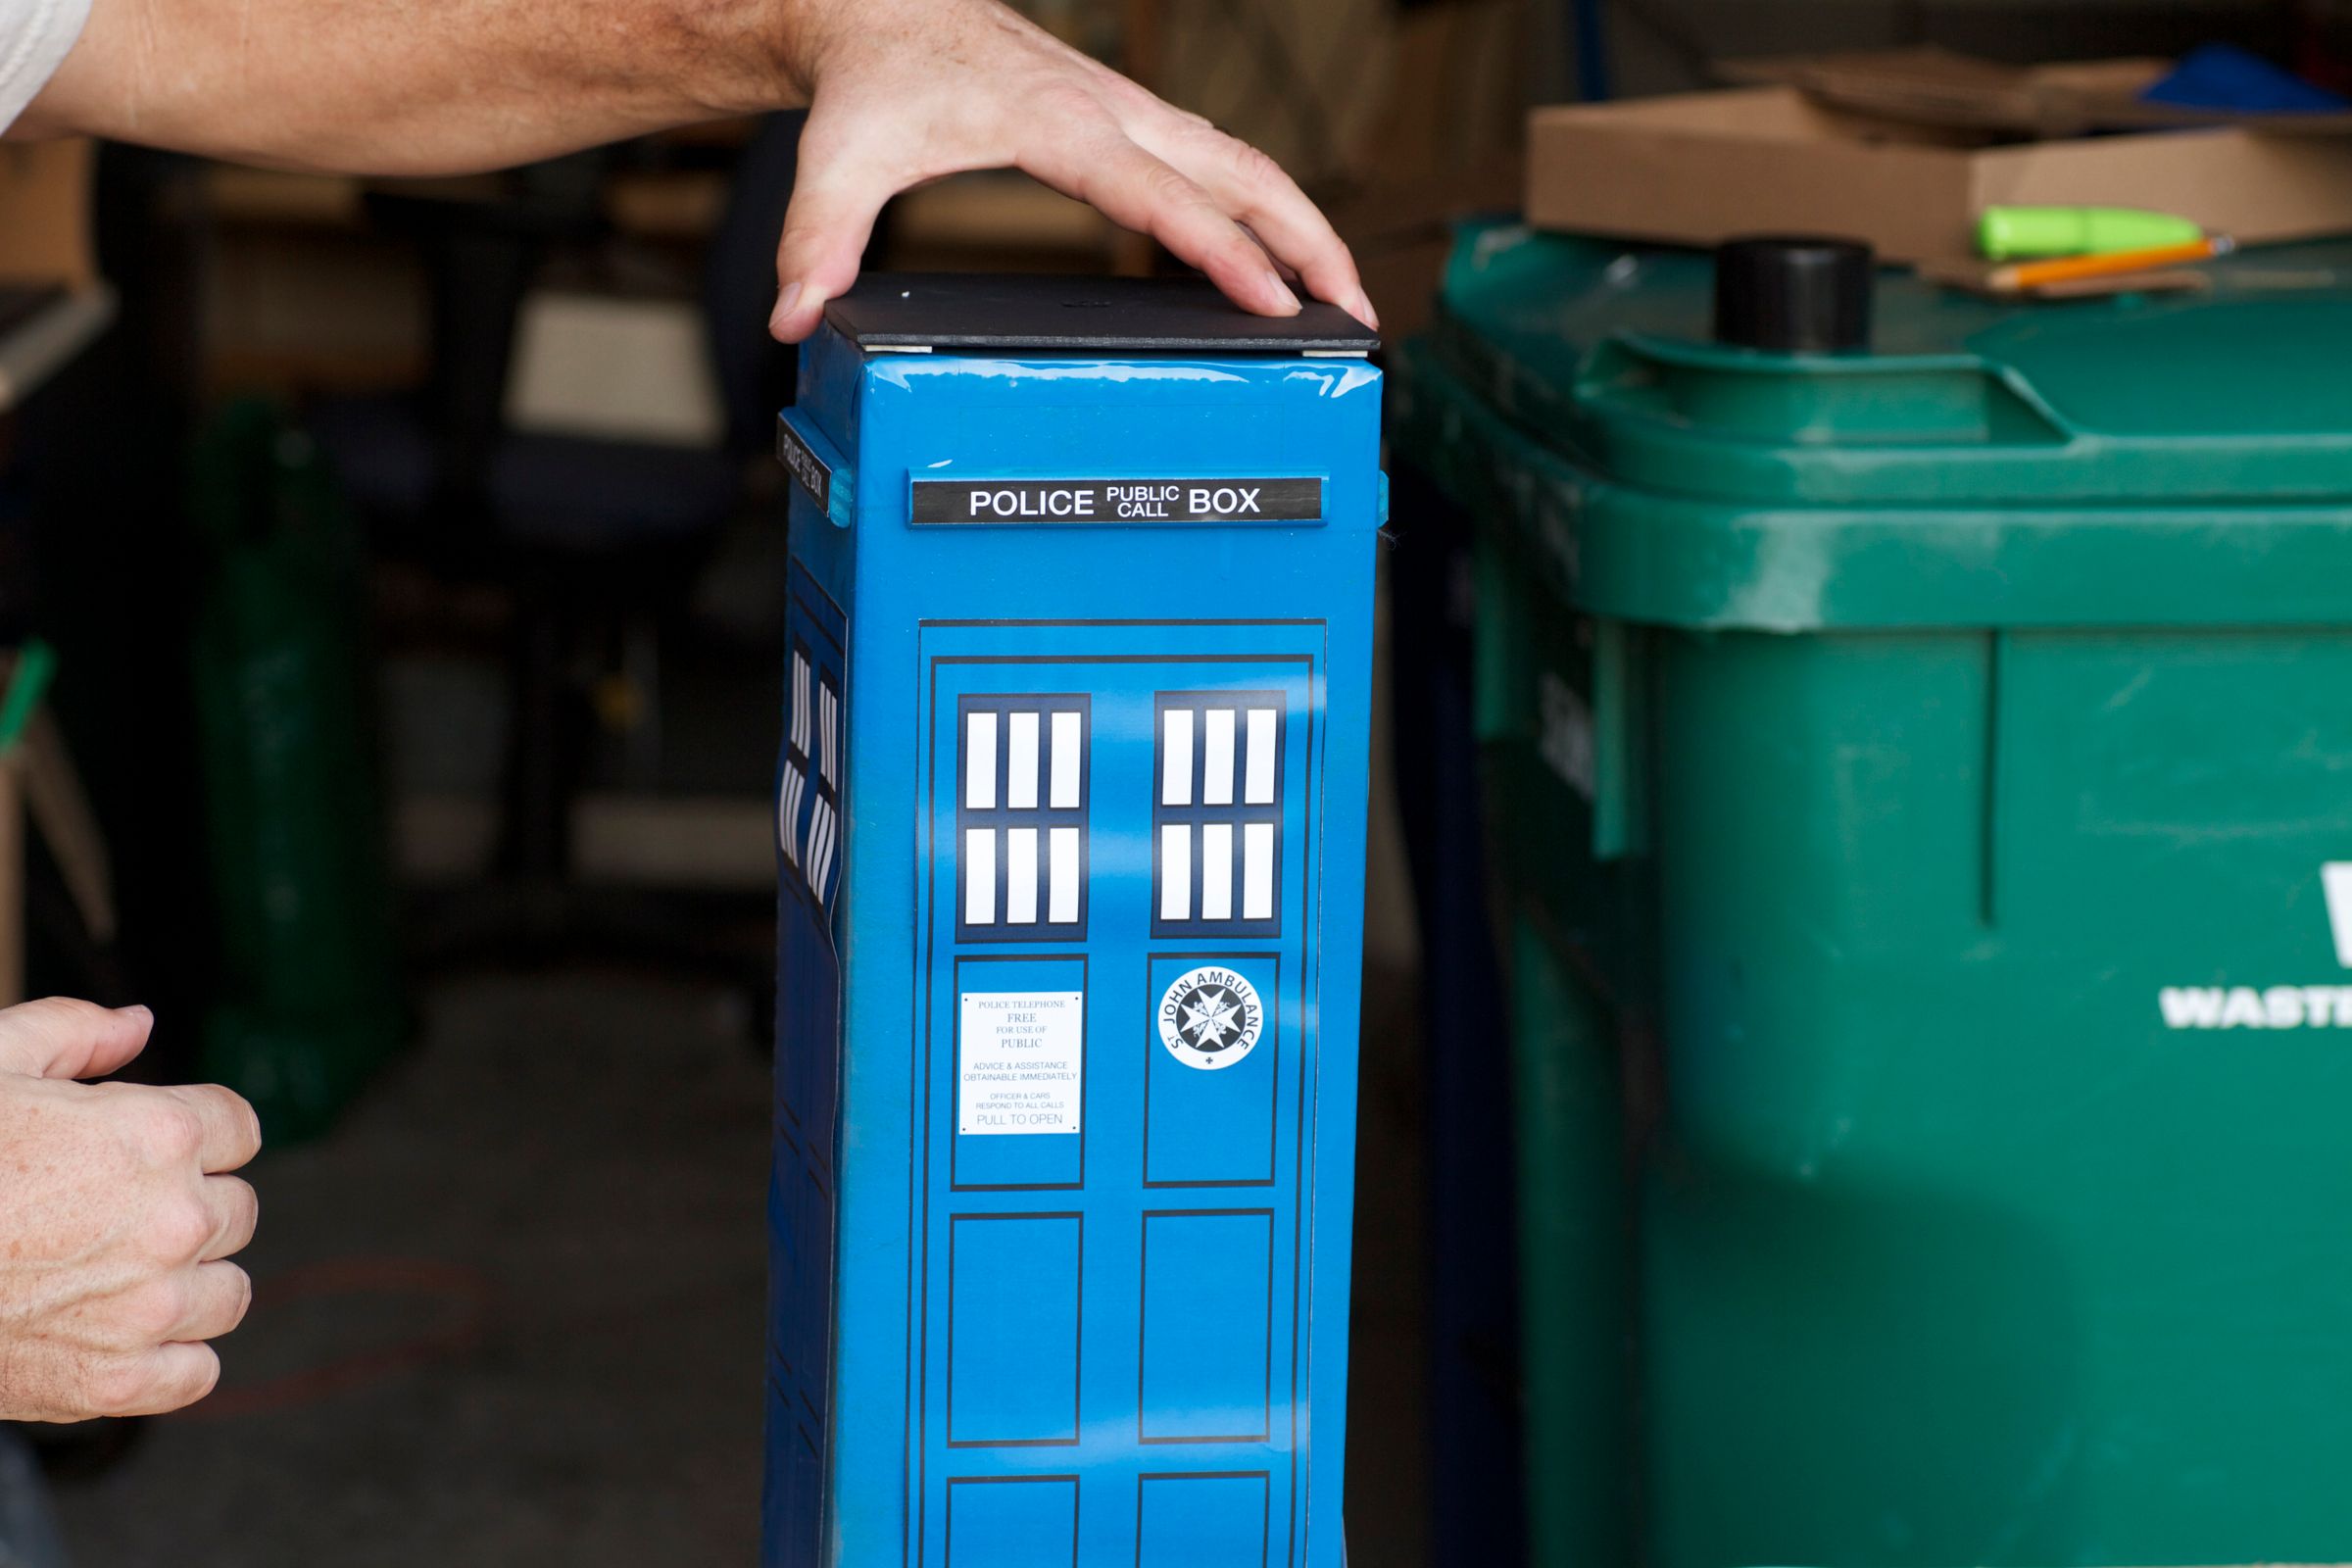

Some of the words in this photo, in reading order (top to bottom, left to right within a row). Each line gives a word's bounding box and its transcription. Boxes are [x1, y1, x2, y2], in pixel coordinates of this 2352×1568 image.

[969, 489, 1095, 516] POLICE
[1106, 485, 1180, 504] PUBLIC
[1188, 487, 1261, 514] BOX
[1116, 502, 1169, 518] CALL
[1163, 979, 1193, 1025] JOHN
[1197, 970, 1259, 1051] AMBULANCE
[1007, 1013, 1037, 1022] FREE
[1002, 1039, 1042, 1049] PUBLIC
[1167, 1035, 1184, 1049] ST
[977, 1114, 1005, 1125] PULL
[1010, 1114, 1026, 1124] TO
[1030, 1113, 1062, 1124] OPEN
